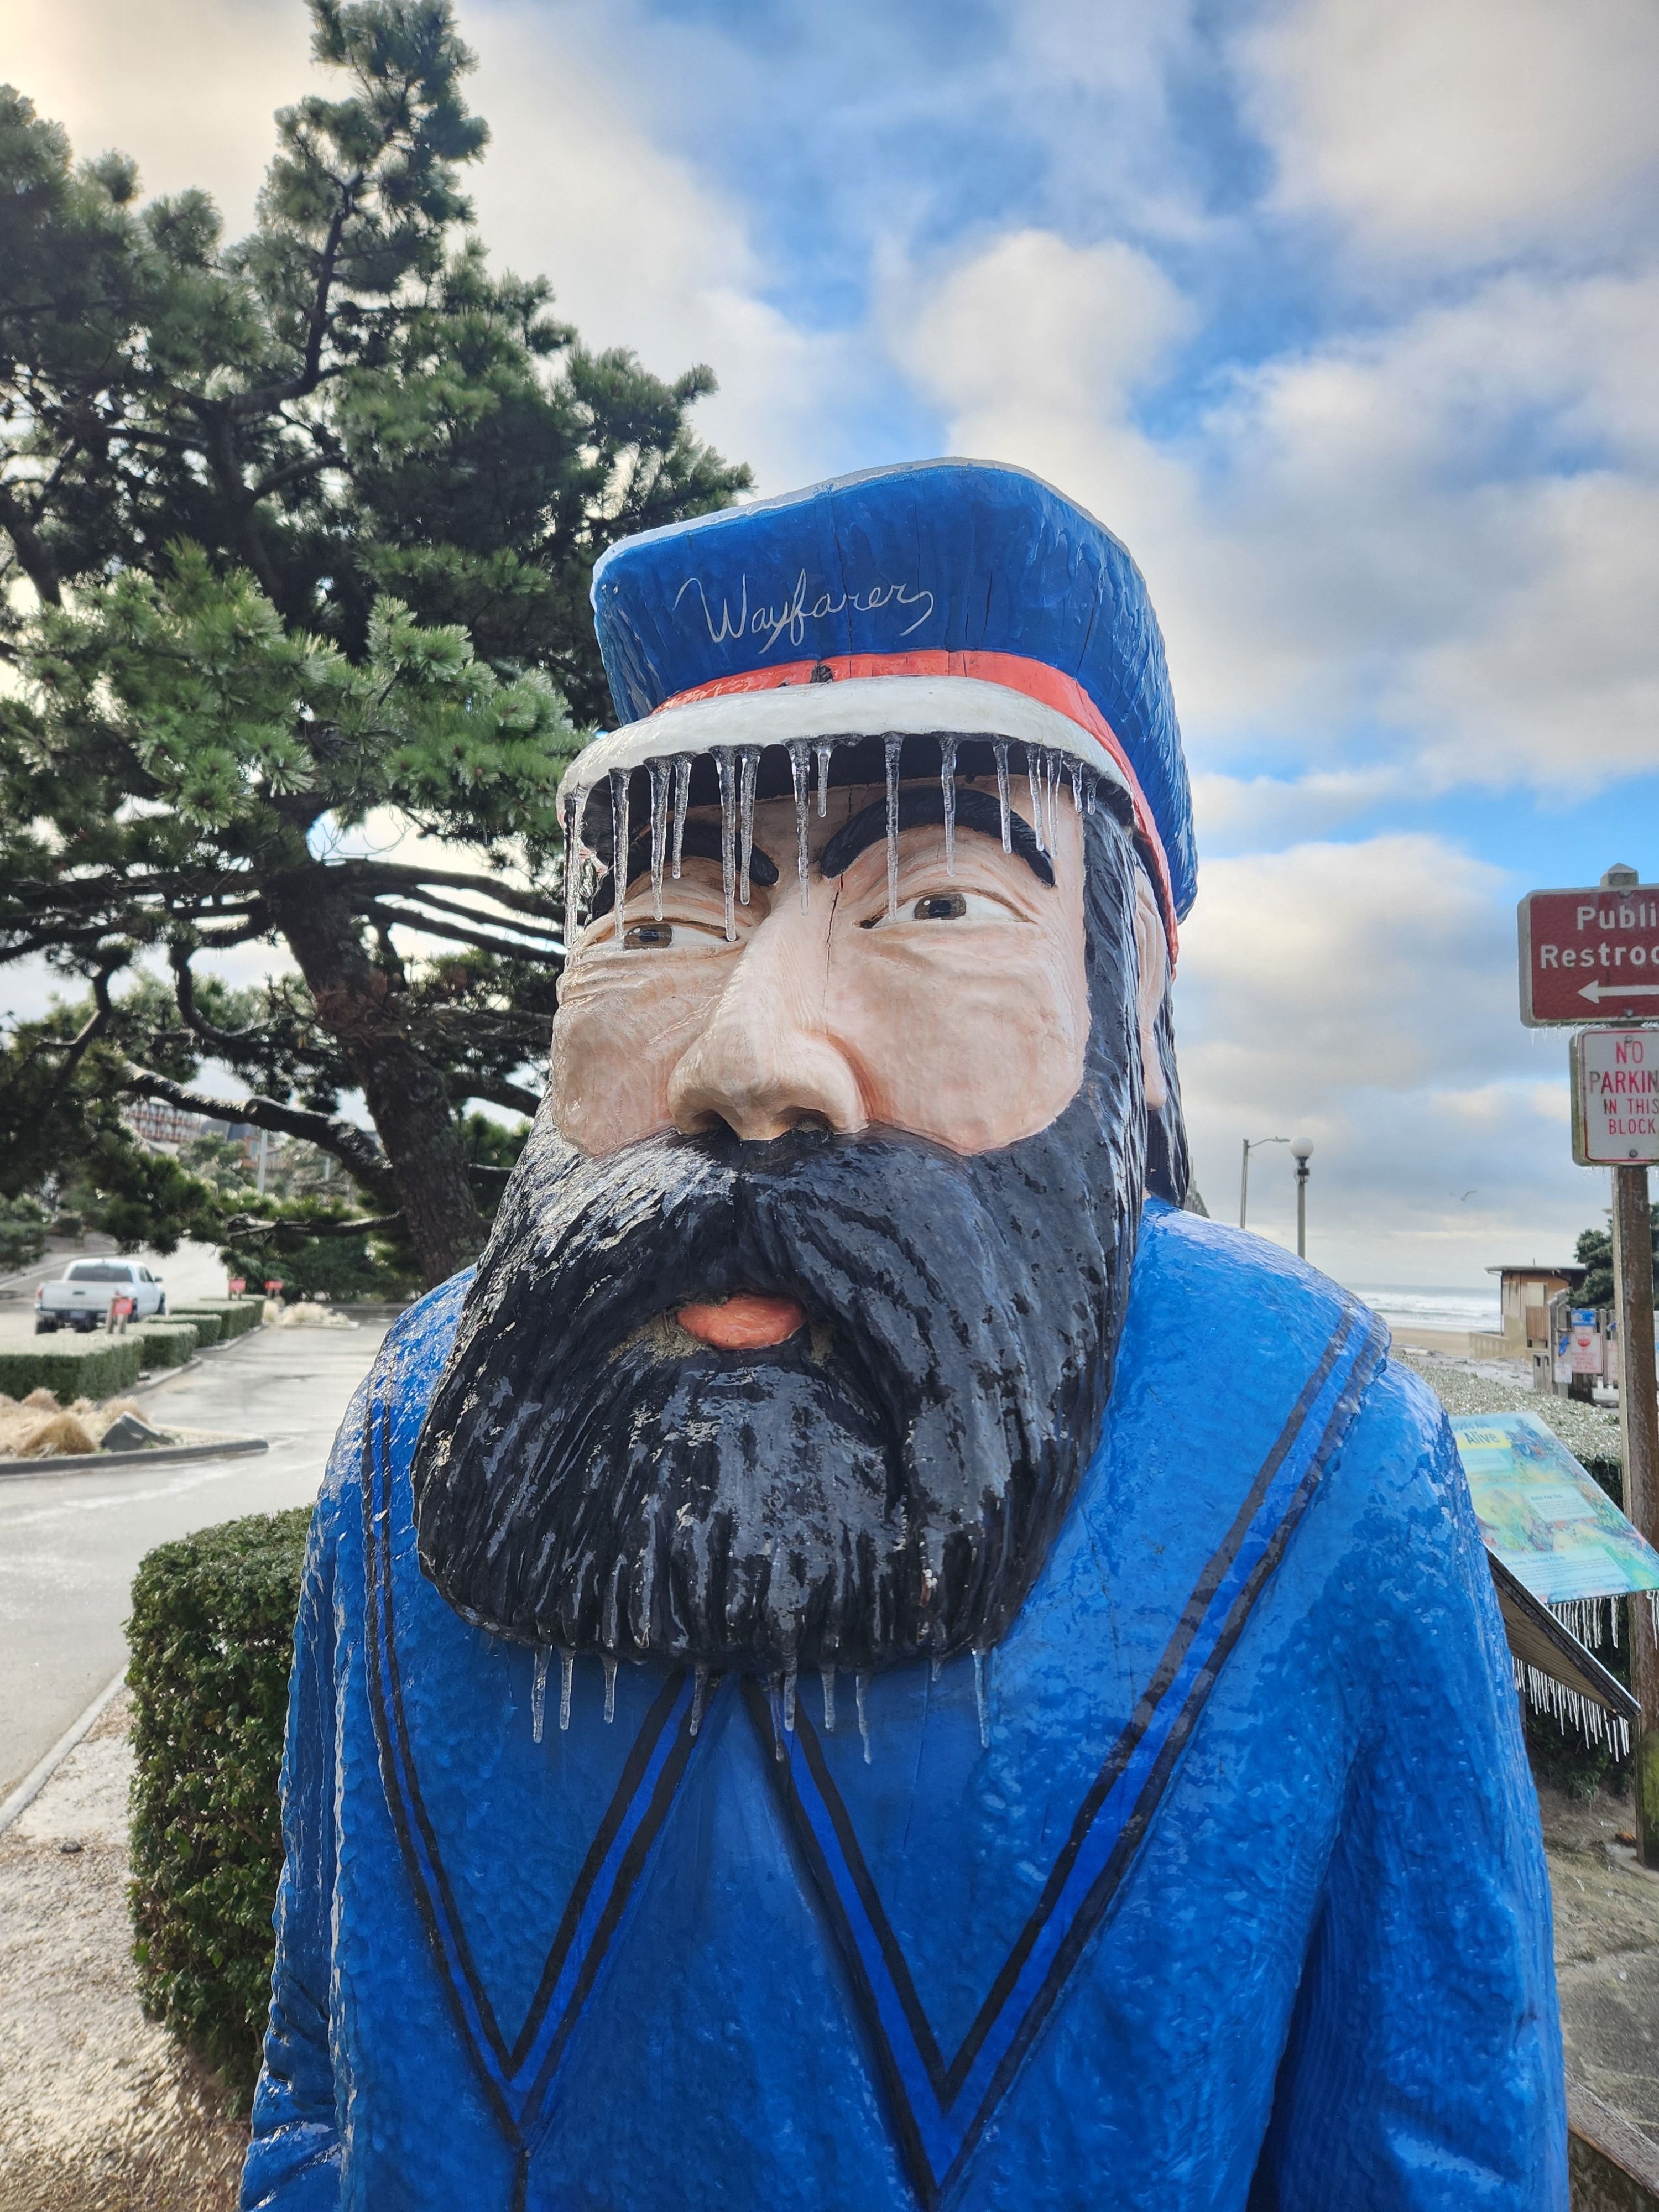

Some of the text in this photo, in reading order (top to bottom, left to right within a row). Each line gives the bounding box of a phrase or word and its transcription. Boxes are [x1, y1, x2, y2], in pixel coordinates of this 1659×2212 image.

[673, 567, 934, 654] Wayfarer
[1616, 1041, 1644, 1064] NO
[1604, 1099, 1617, 1114] IN
[1627, 1098, 1659, 1114] THIS
[1609, 1118, 1656, 1134] BLOCK
[1463, 1431, 1500, 1444] Alive
